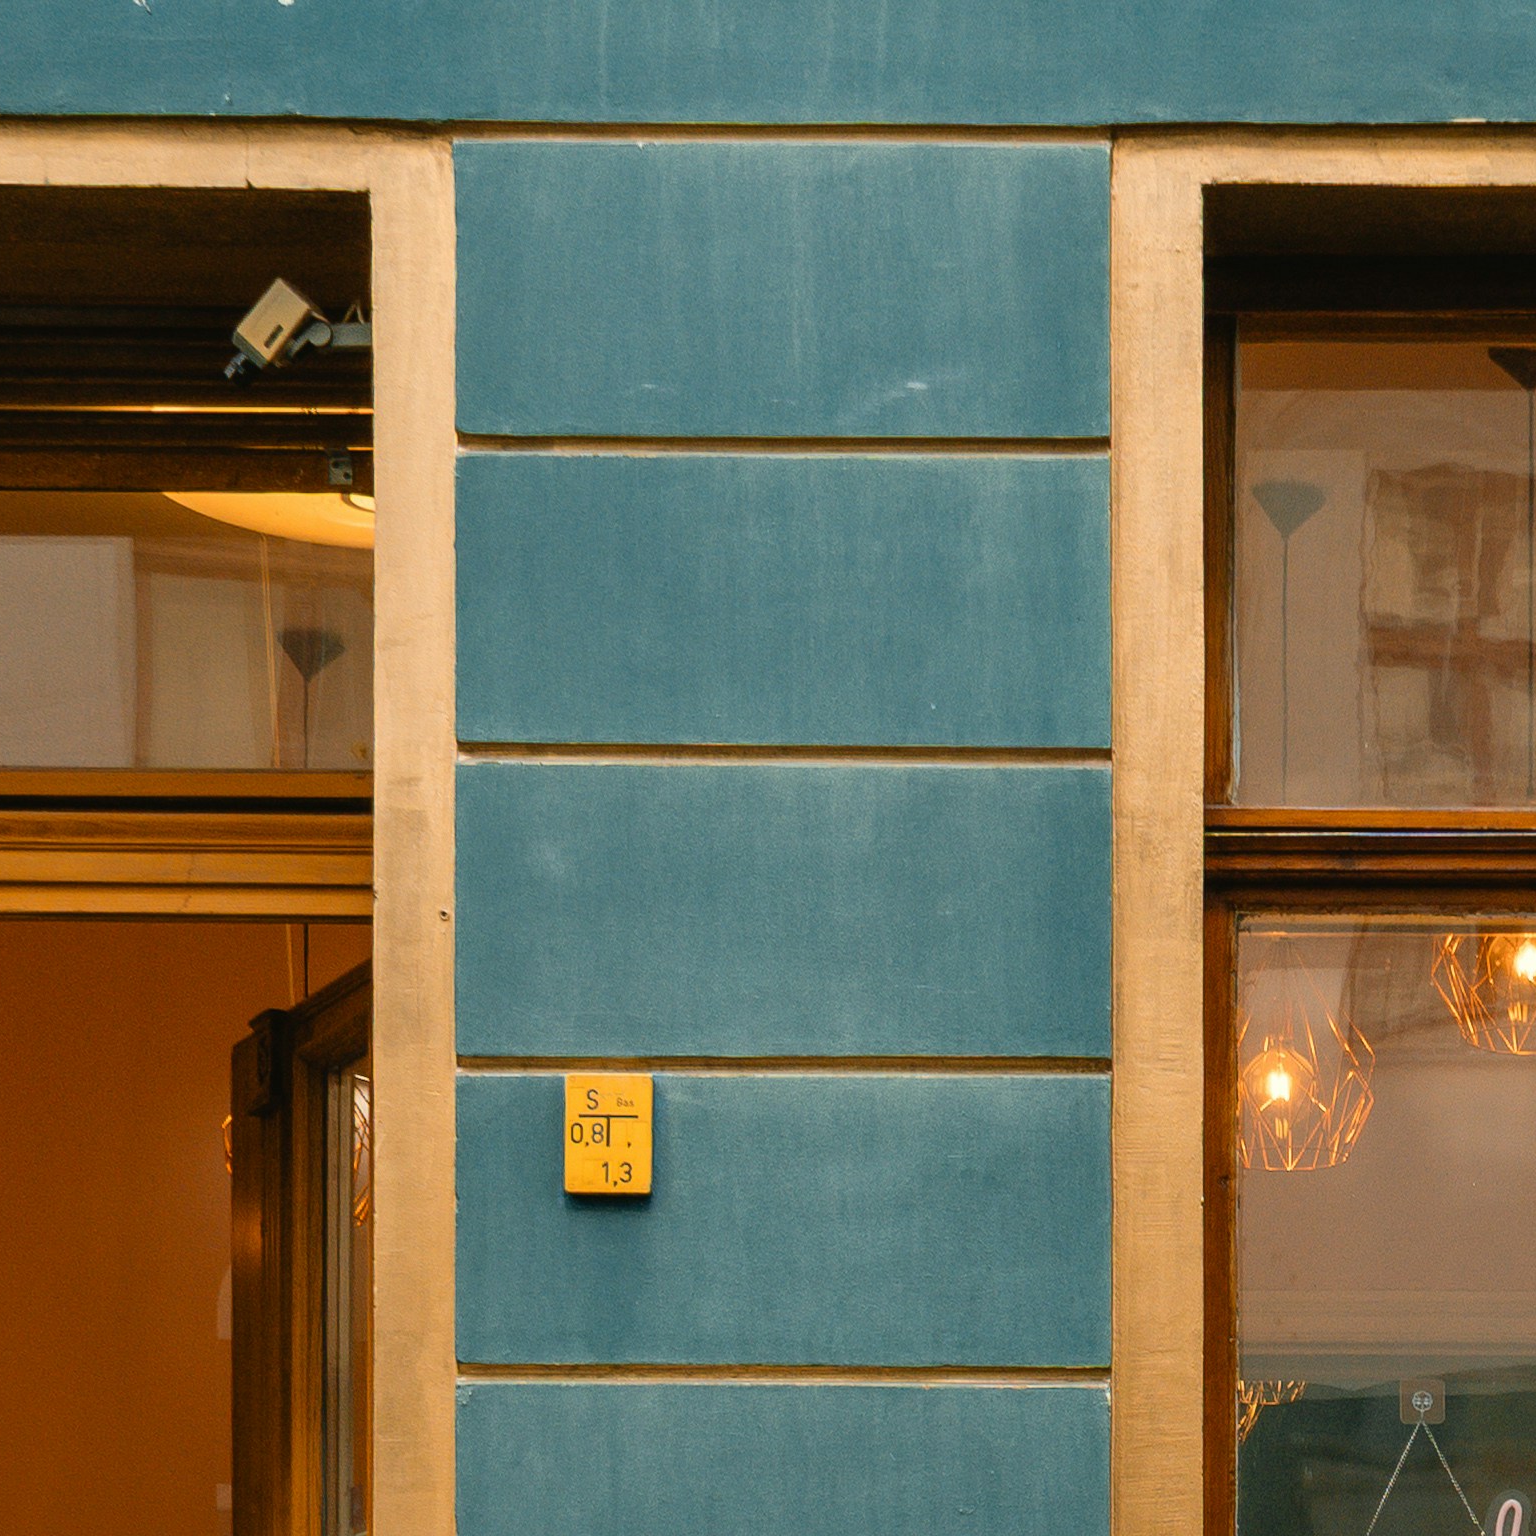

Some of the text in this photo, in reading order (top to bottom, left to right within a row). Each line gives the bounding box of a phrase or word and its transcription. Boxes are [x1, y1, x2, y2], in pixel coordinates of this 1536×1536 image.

[586, 1088, 599, 1111] S
[570, 1122, 604, 1147] 0,8
[601, 1161, 633, 1187] 1,3
